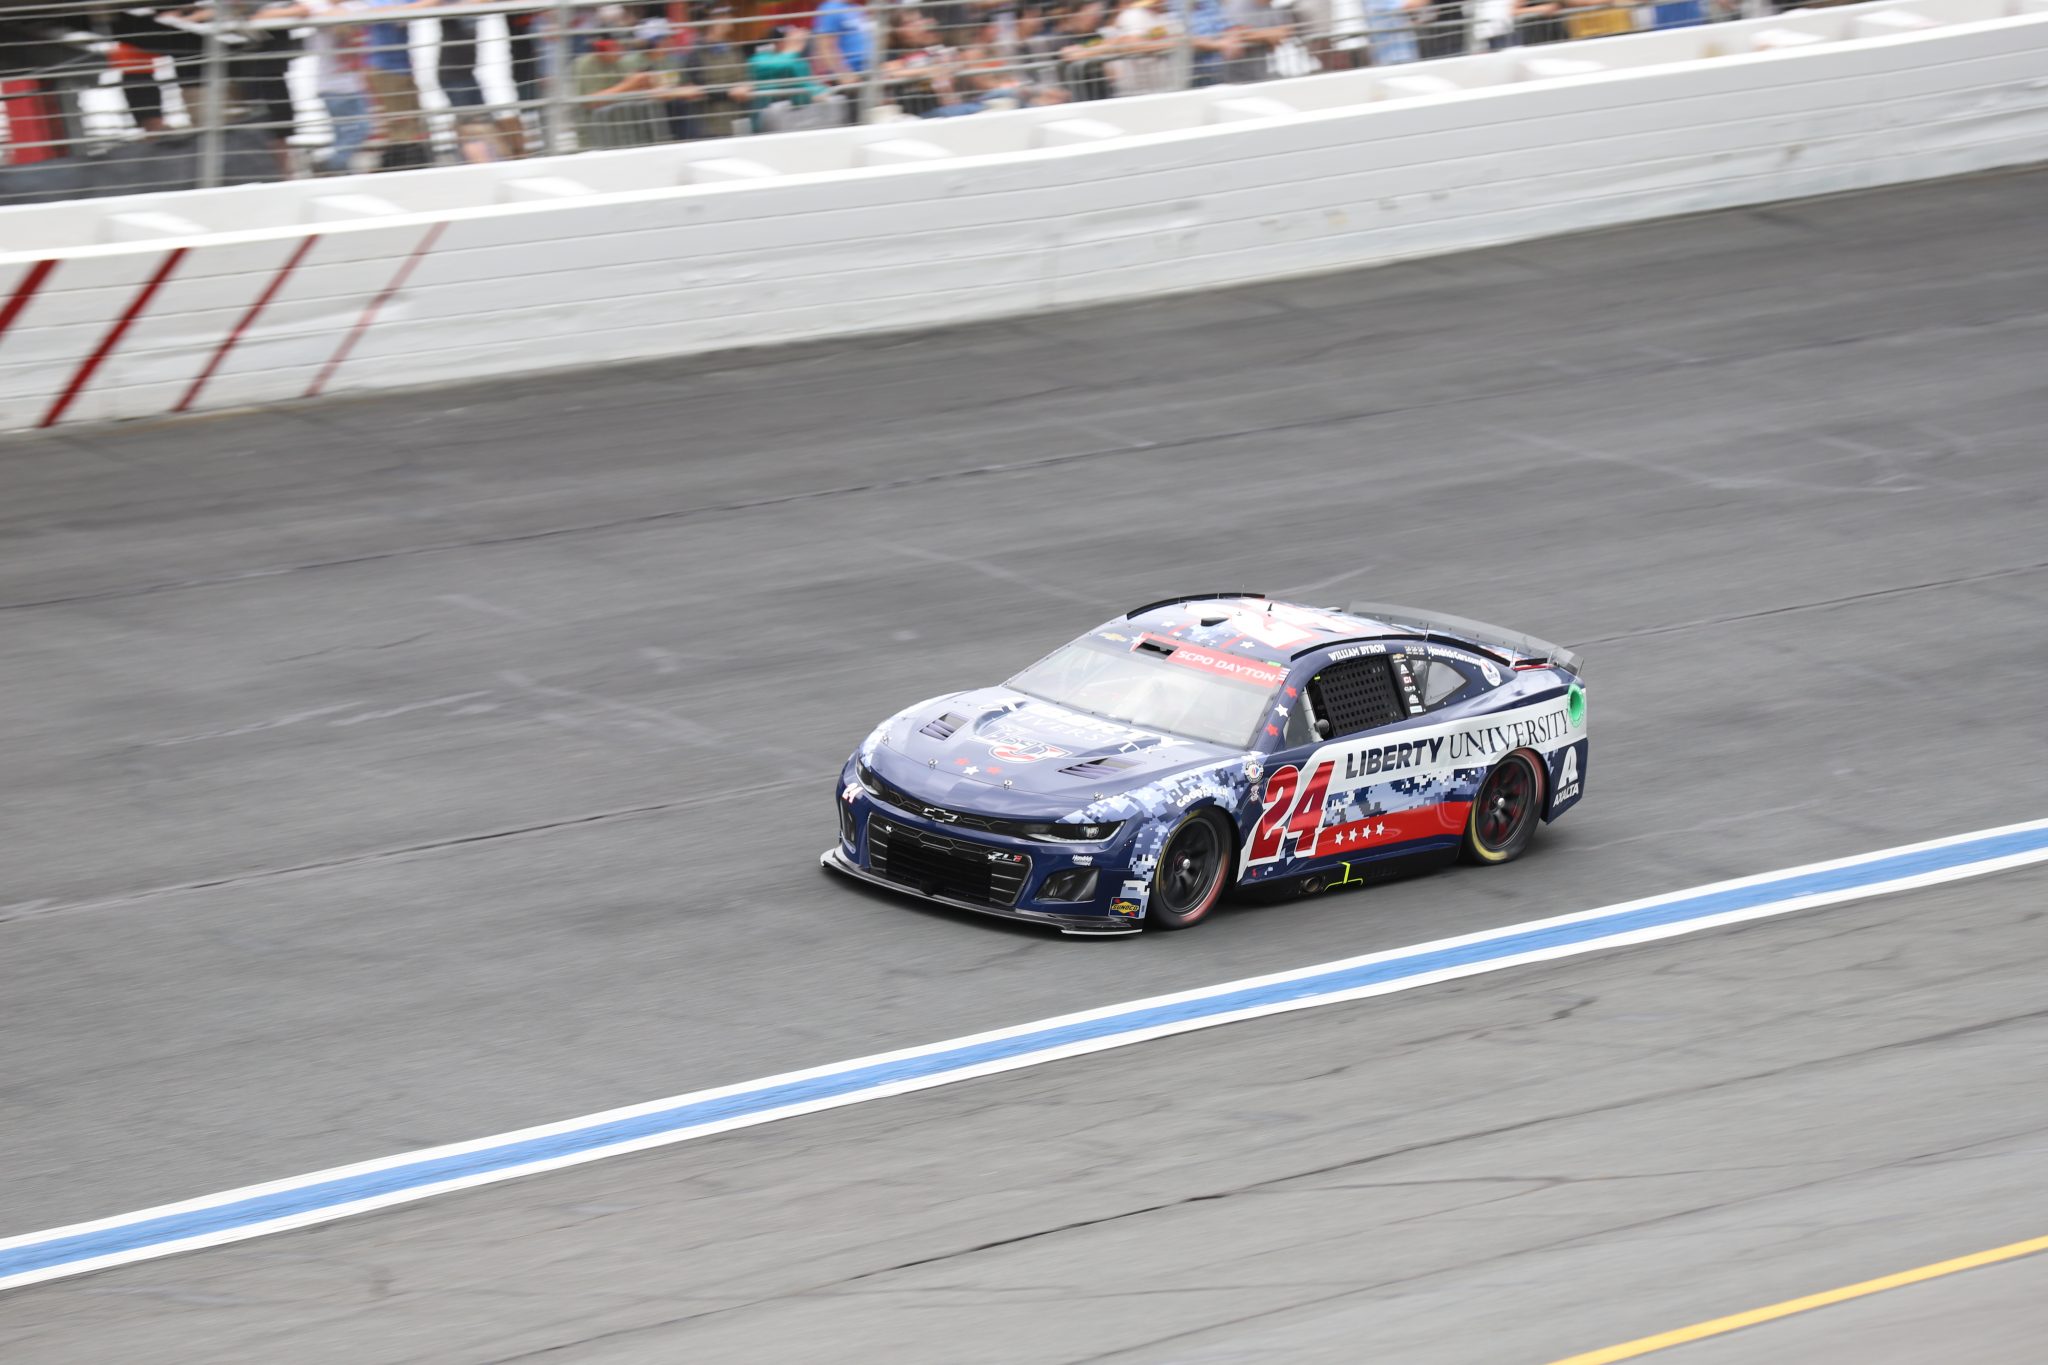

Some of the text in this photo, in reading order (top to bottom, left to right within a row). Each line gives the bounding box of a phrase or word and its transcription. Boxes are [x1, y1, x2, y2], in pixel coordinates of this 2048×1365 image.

[1176, 650, 1277, 682] SCPO DAYTON
[1328, 644, 1387, 662] WILLIAM BYRON
[1345, 707, 1569, 780] LIBERTY UNIVERSITY
[1553, 782, 1580, 808] AXALTA
[1247, 760, 1337, 866] 24
